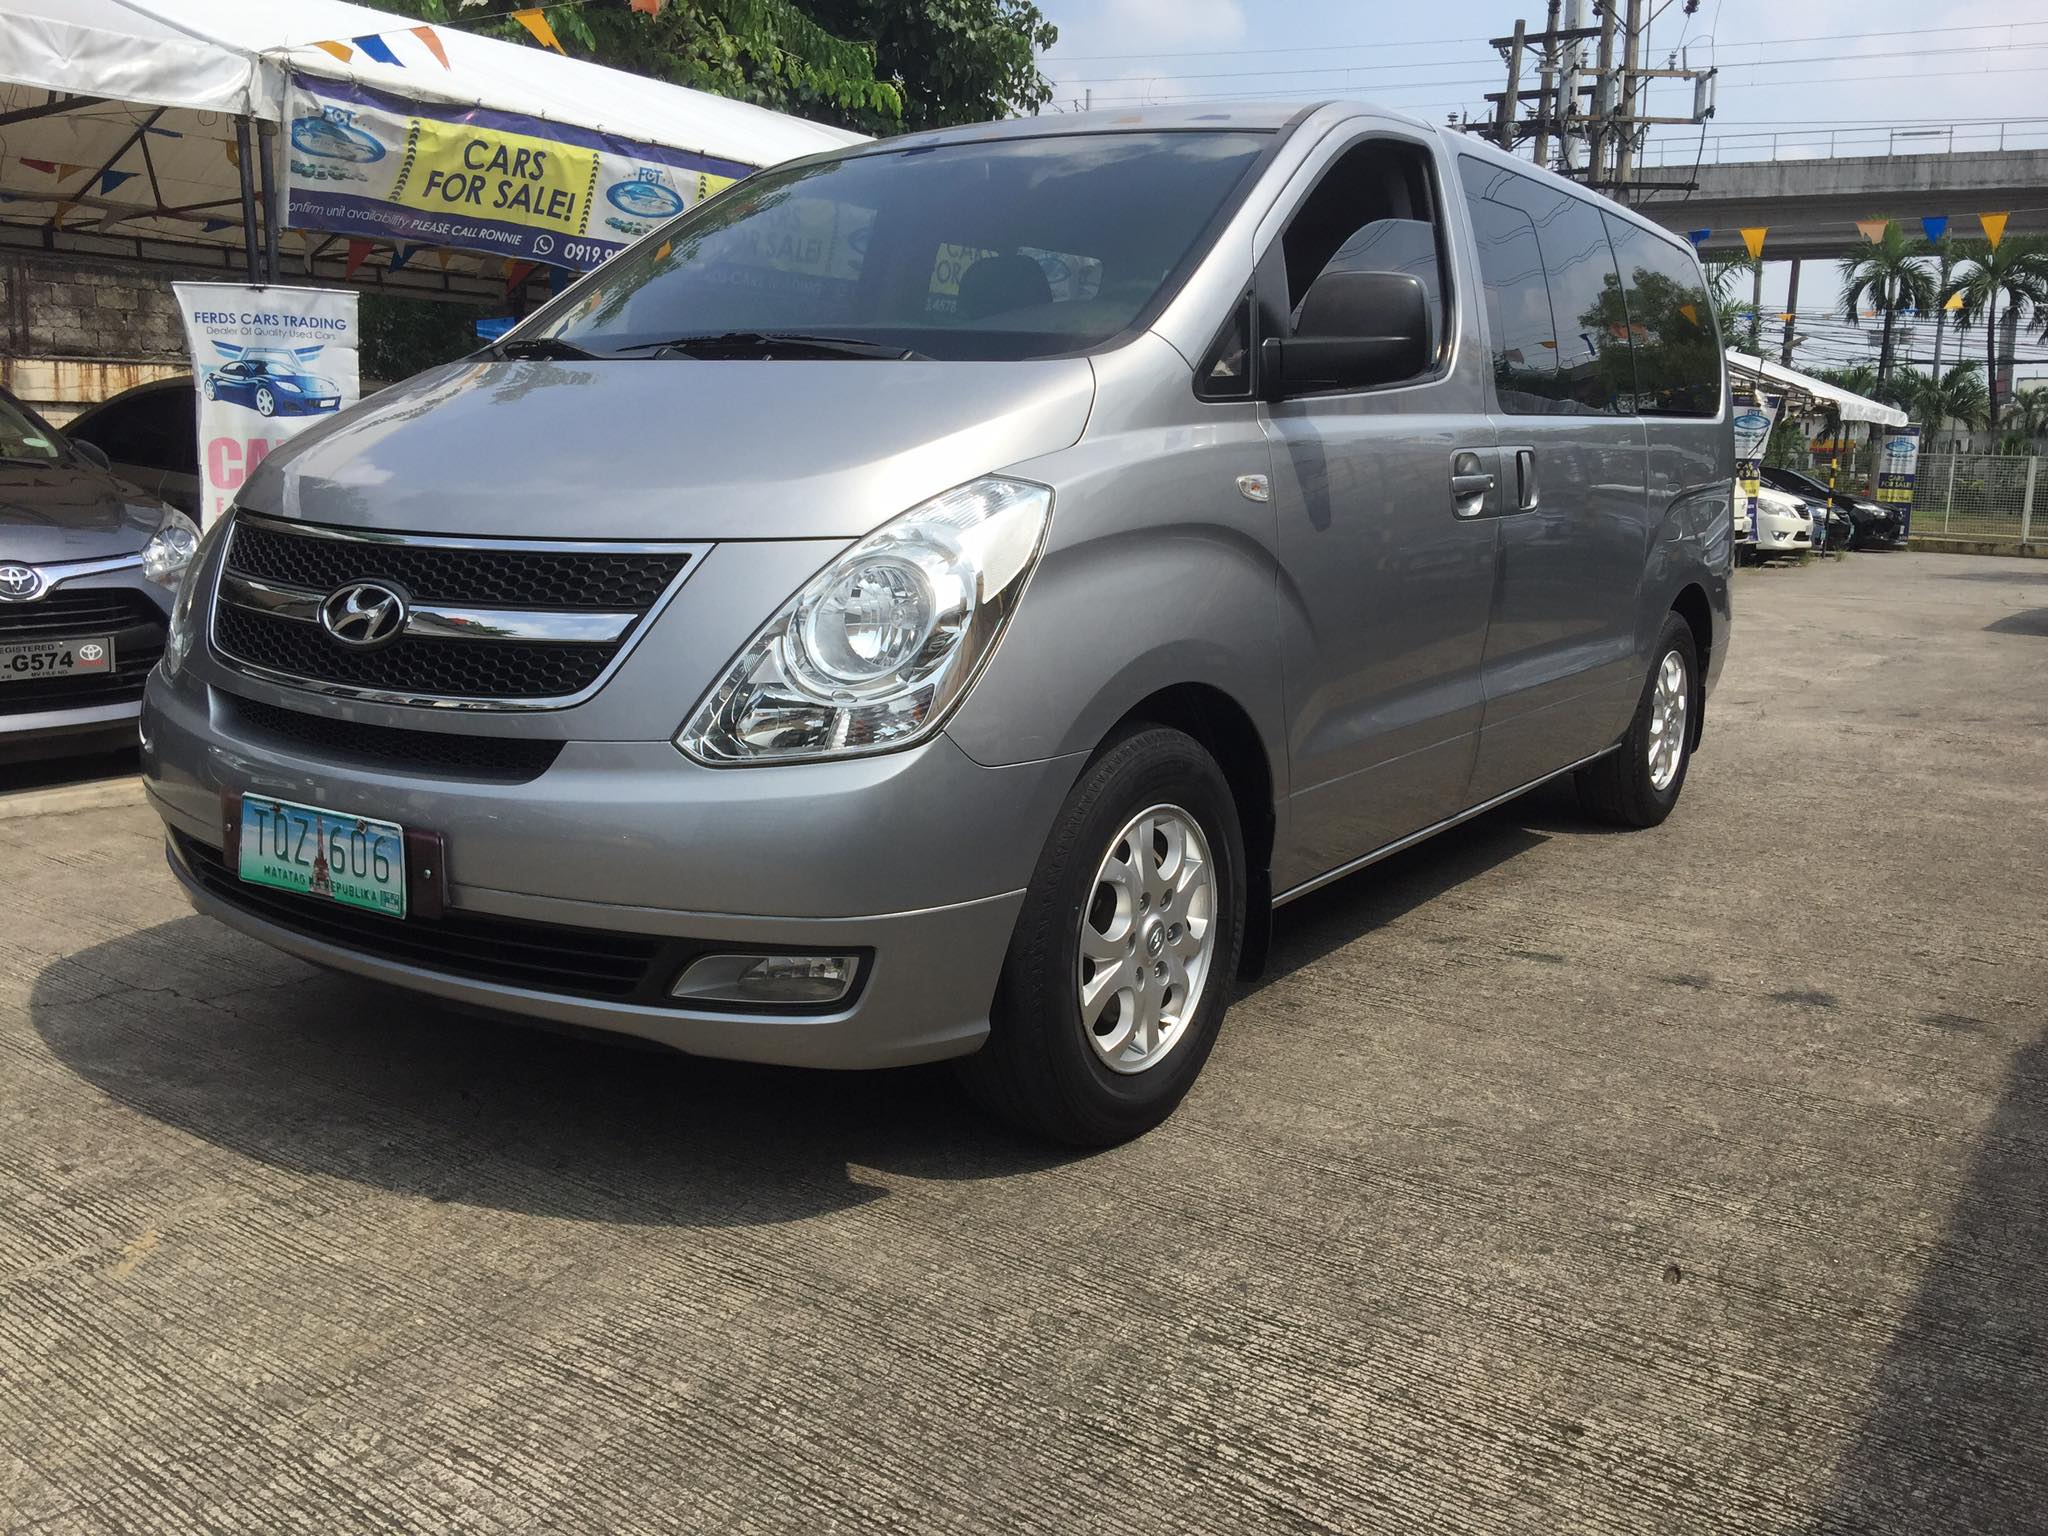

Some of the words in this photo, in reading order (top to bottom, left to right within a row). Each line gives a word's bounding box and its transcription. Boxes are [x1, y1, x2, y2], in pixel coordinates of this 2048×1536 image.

[464, 139, 547, 181] CARS
[422, 171, 486, 205] FOR
[493, 180, 576, 222] SALE!
[288, 202, 324, 215] onfirm
[327, 205, 346, 217] unit
[347, 208, 409, 228] availability
[410, 219, 450, 234] PLEASE
[451, 225, 478, 238] CALL
[479, 228, 522, 246] RONNIE
[194, 312, 236, 325] FERDS
[240, 313, 279, 326] CARS
[283, 315, 346, 331] TRADING
[206, 326, 237, 336] Dealer
[254, 327, 287, 338] Quality
[289, 329, 312, 339] Used
[0, 644, 54, 654] EGISTERED
[254, 808, 311, 866] TQZ
[329, 825, 389, 883] 606
[263, 865, 306, 886] MATATAG
[325, 879, 378, 901] REPUBLIKA
